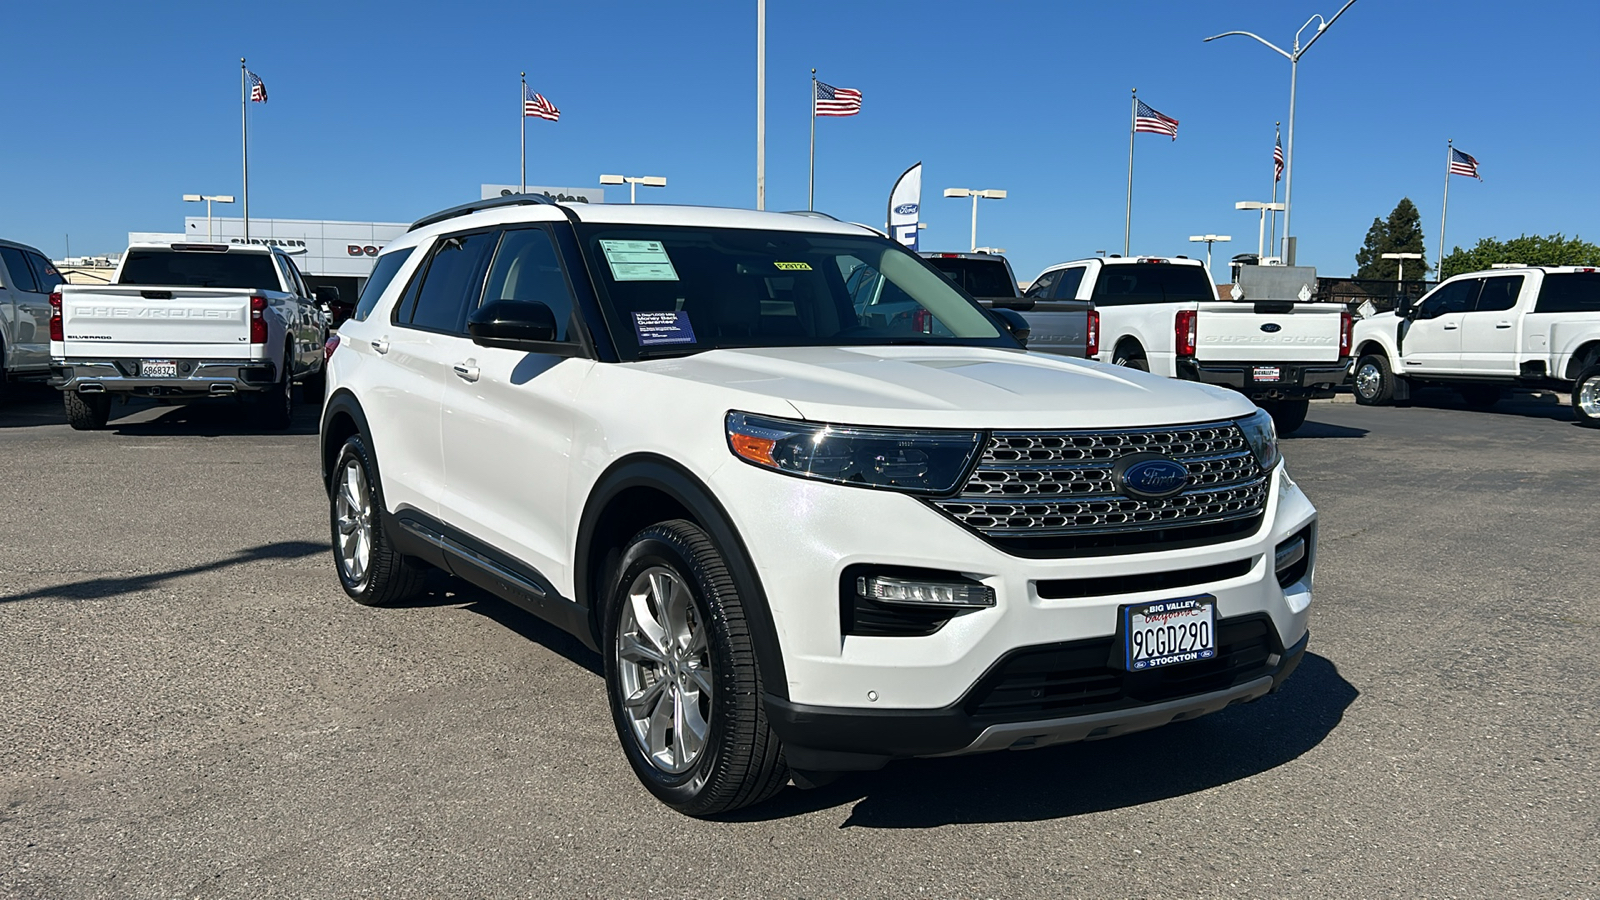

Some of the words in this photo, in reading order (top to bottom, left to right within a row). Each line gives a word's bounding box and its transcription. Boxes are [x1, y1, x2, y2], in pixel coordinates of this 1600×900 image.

[899, 204, 918, 214] Ford
[74, 306, 238, 319] CHEVROLET
[1204, 335, 1276, 344] SUPER
[1281, 335, 1334, 344] DUTY
[1141, 467, 1176, 487] Ford
[1149, 604, 1164, 613] BIG
[1166, 600, 1196, 611] VALLEY
[1133, 620, 1209, 660] 9CGD290
[1149, 652, 1198, 667] STOCKTON
